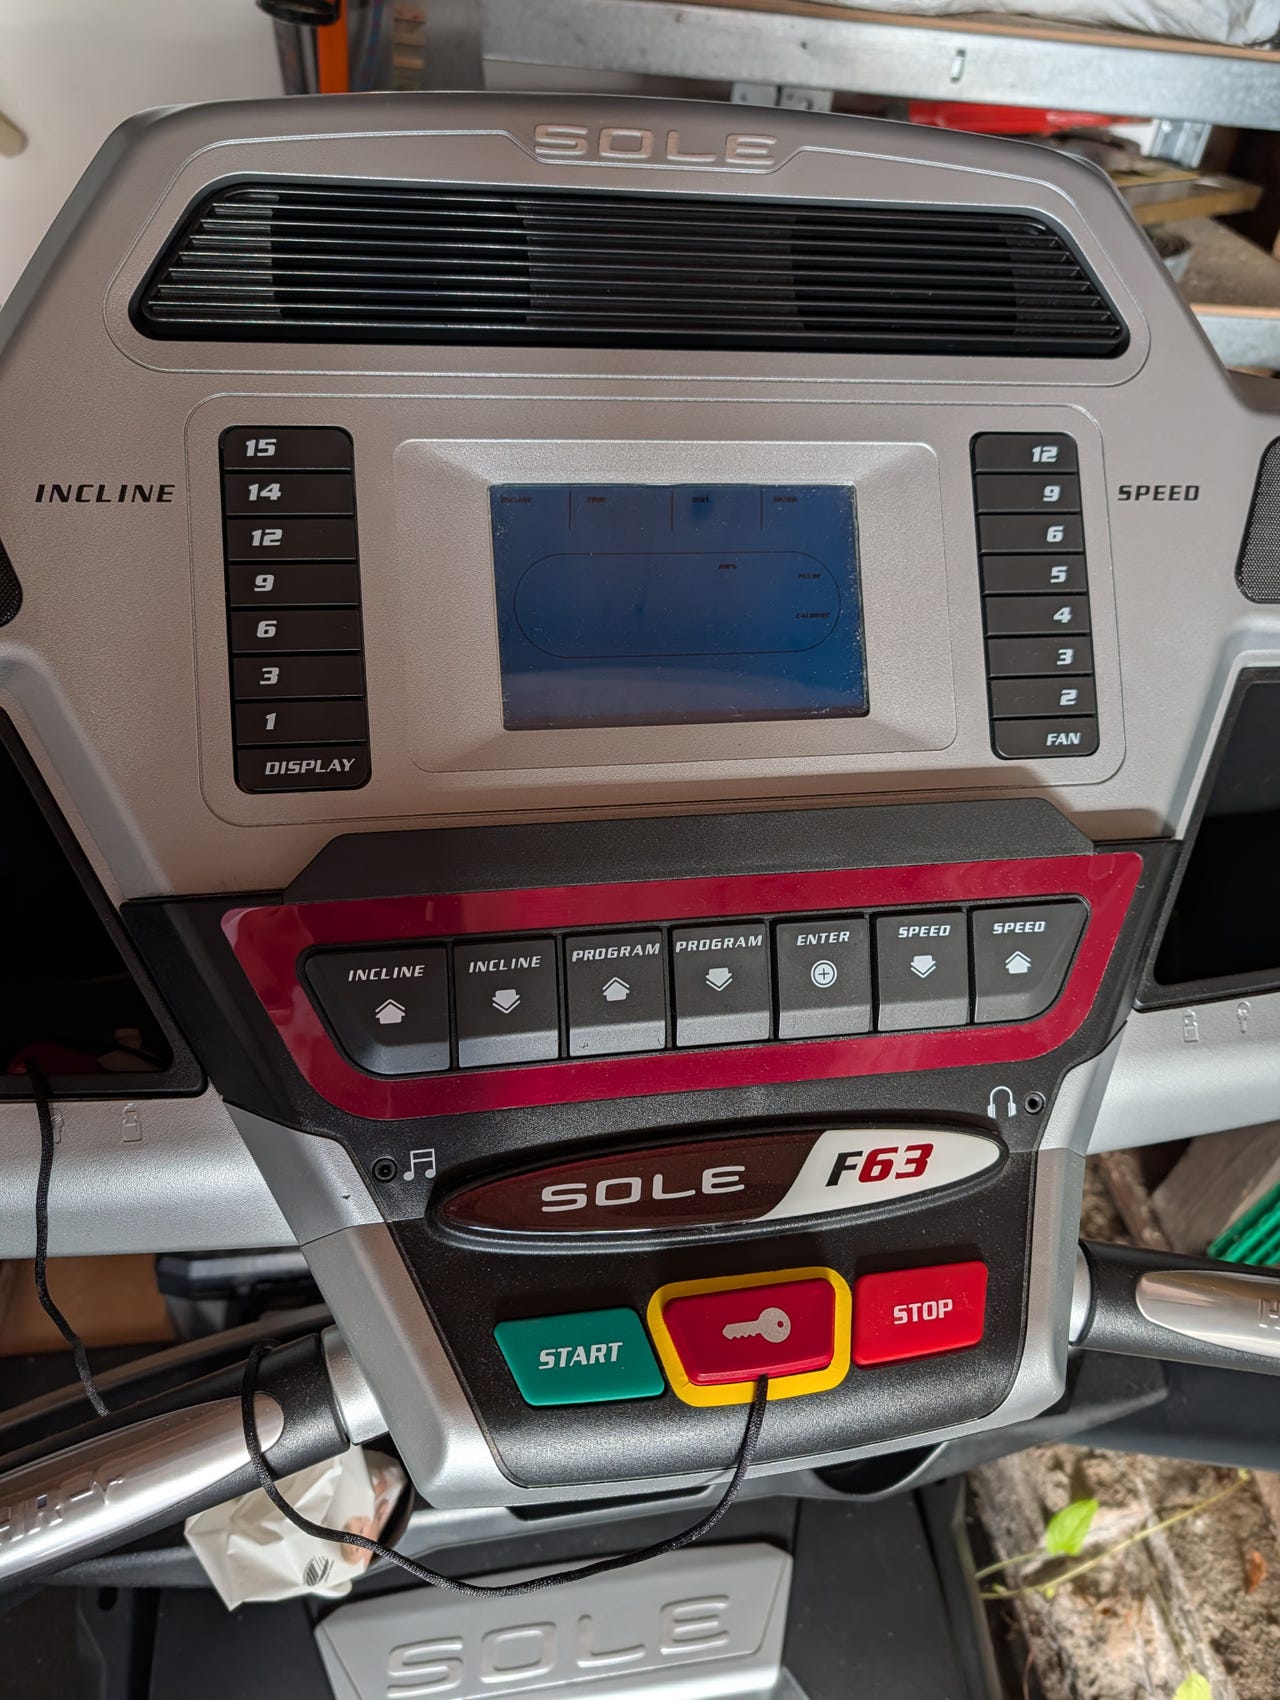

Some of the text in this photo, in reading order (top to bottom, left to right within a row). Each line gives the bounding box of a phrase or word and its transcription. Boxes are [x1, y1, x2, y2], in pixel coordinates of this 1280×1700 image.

[534, 123, 777, 164] SOLE
[245, 438, 277, 457] 15
[1032, 446, 1058, 463] 12
[35, 484, 176, 503] INCLINE
[248, 483, 282, 501] 14
[1043, 485, 1061, 502] 9
[1117, 484, 1200, 501] SPEED
[251, 528, 283, 547] 12
[1046, 525, 1064, 543] 6
[254, 574, 275, 592] 9
[1050, 565, 1068, 584] 5
[1053, 606, 1072, 624] 4
[256, 620, 278, 638] 6
[1056, 648, 1074, 665] 3
[259, 667, 280, 685] 3
[1059, 689, 1078, 706] 2
[265, 712, 277, 730] 1
[1046, 732, 1081, 746] FAN
[264, 758, 356, 775] DISPLAY
[898, 925, 951, 938] SPEED
[992, 921, 1046, 934] SPEED
[675, 934, 763, 953] PROGRAM
[796, 931, 850, 946] ENTER
[572, 942, 660, 962] PROGRAM
[348, 964, 425, 982] INCLINE
[468, 955, 542, 973] INCLINE
[541, 1142, 935, 1212] SOLE F63
[893, 1298, 953, 1325] STOP
[538, 1341, 624, 1370] START
[386, 1595, 730, 1699] SOLE
